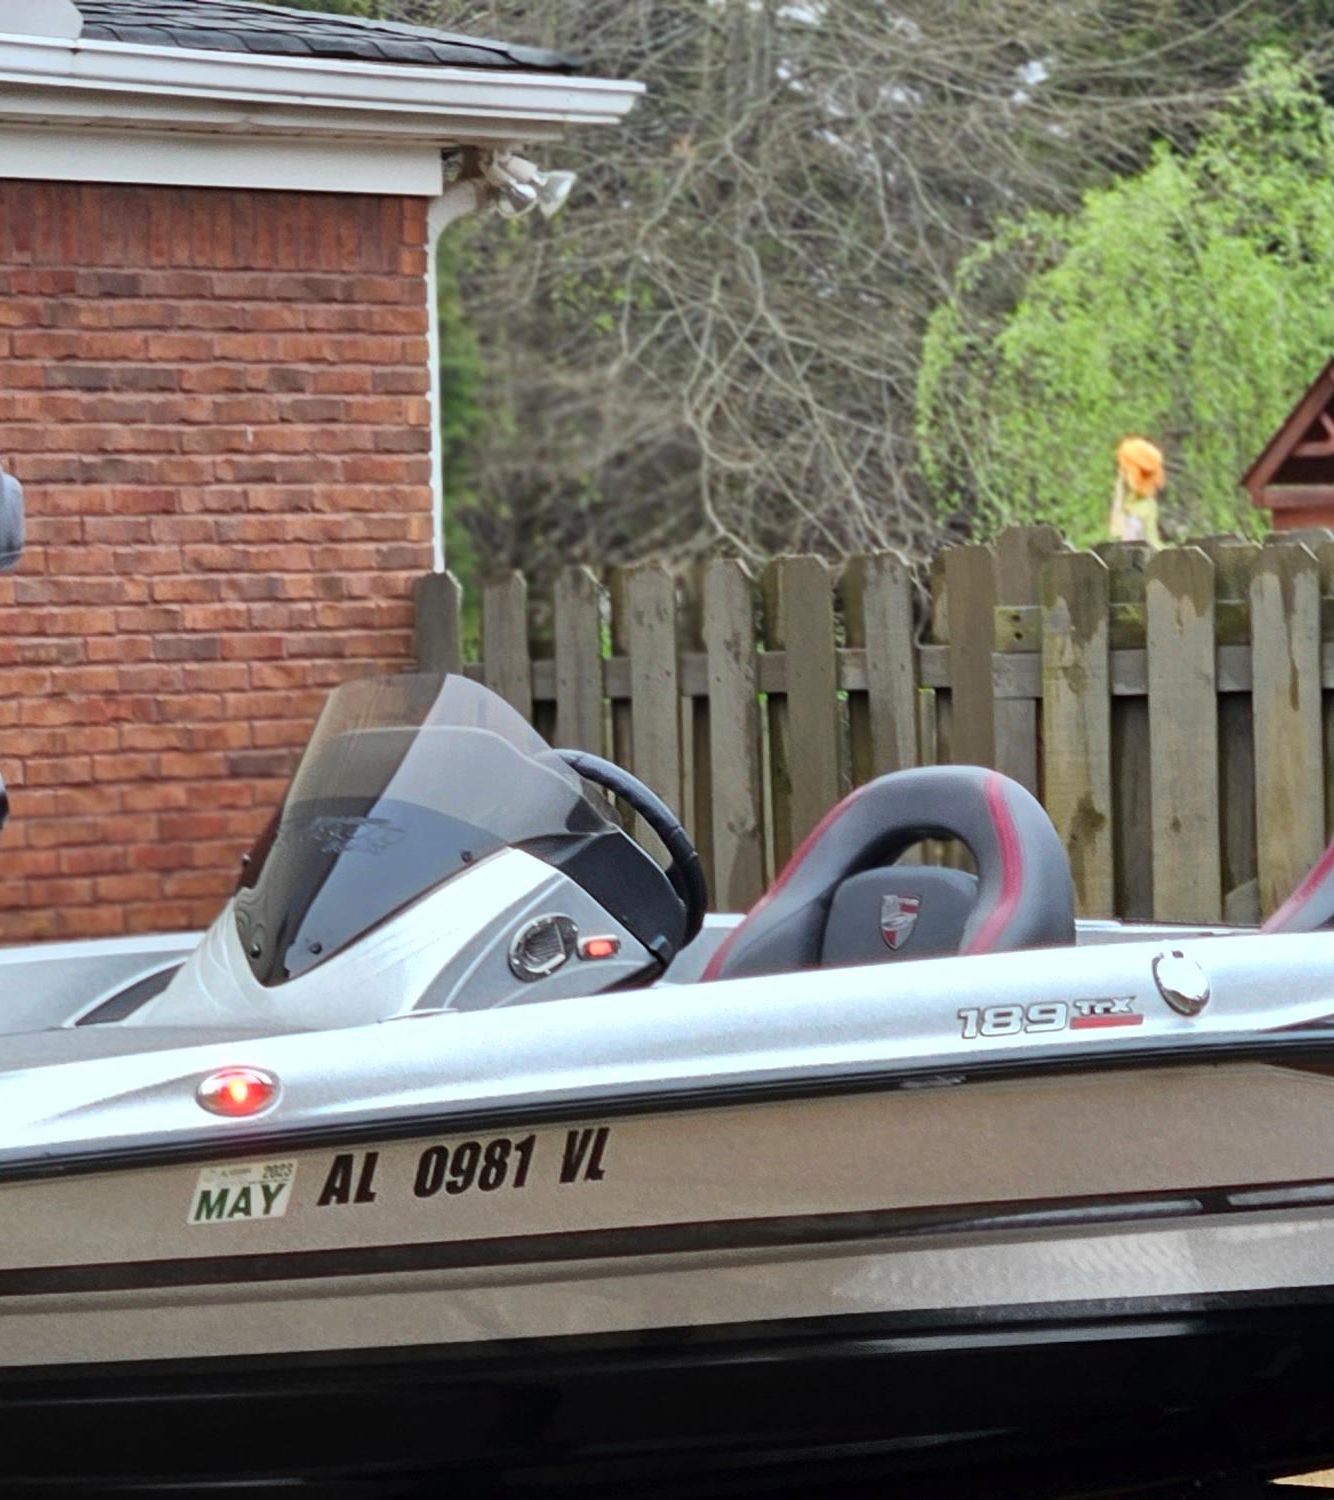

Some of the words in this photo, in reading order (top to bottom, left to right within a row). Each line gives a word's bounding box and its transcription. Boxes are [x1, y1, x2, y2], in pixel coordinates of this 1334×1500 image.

[957, 1000, 1068, 1040] 189
[317, 1152, 379, 1206] AL
[414, 1135, 535, 1199] 0981
[560, 1126, 610, 1183] VL
[194, 1183, 287, 1221] MAY
